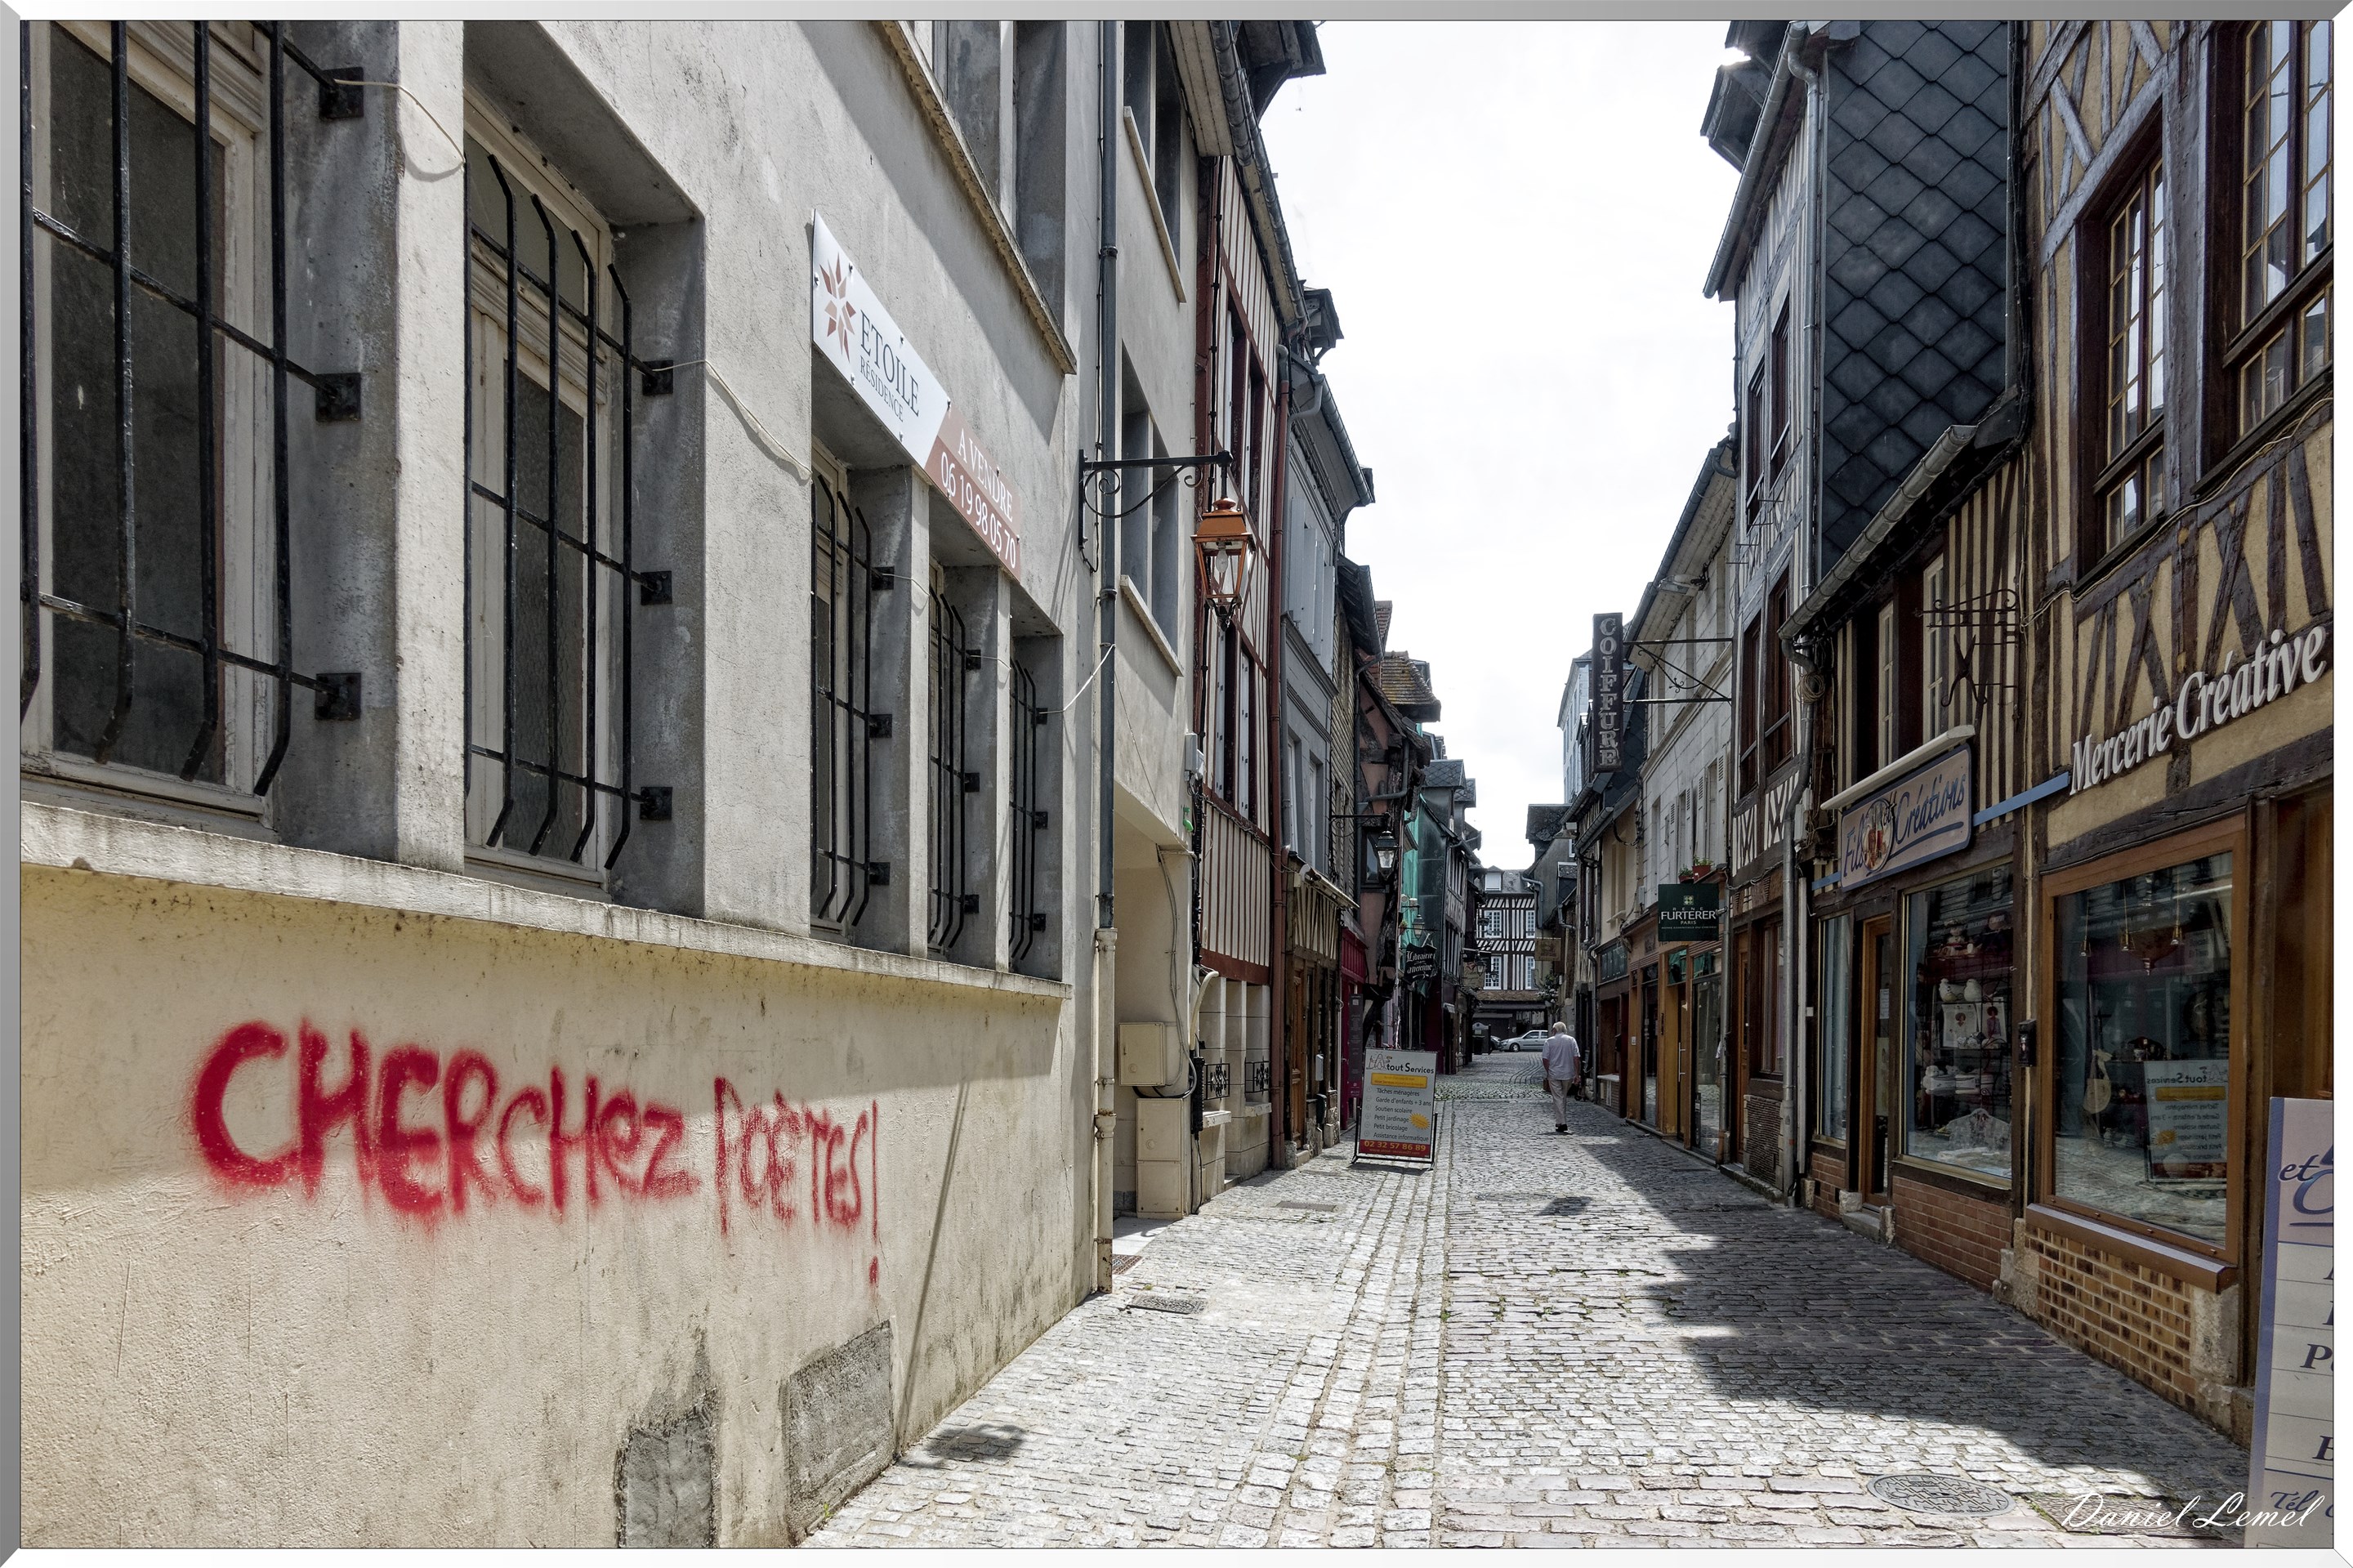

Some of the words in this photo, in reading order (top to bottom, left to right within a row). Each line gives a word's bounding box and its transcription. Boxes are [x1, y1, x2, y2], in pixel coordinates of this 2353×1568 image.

[860, 309, 920, 417] ETOILE
[859, 355, 904, 423] RÉSIDENCE
[958, 427, 967, 462] A
[969, 442, 1014, 523] VENDRE
[940, 451, 957, 497] 06
[959, 474, 973, 515] 19
[975, 493, 989, 536] 98
[989, 512, 1003, 553] 05
[1004, 529, 1016, 570] 70
[1599, 618, 1619, 766] COIFFURE
[2069, 695, 2174, 796] Mercerie
[2176, 625, 2327, 740] Créative
[1895, 772, 1967, 845] Créations
[1661, 910, 1717, 920] FURTERER
[1404, 1062, 1435, 1074] Services
[1386, 1115, 1409, 1124] jardinage
[1386, 1124, 1409, 1132] bricolage
[1398, 1133, 1429, 1141] informatique
[2279, 1154, 2320, 1182] et
[2270, 1490, 2320, 1512] Tél
